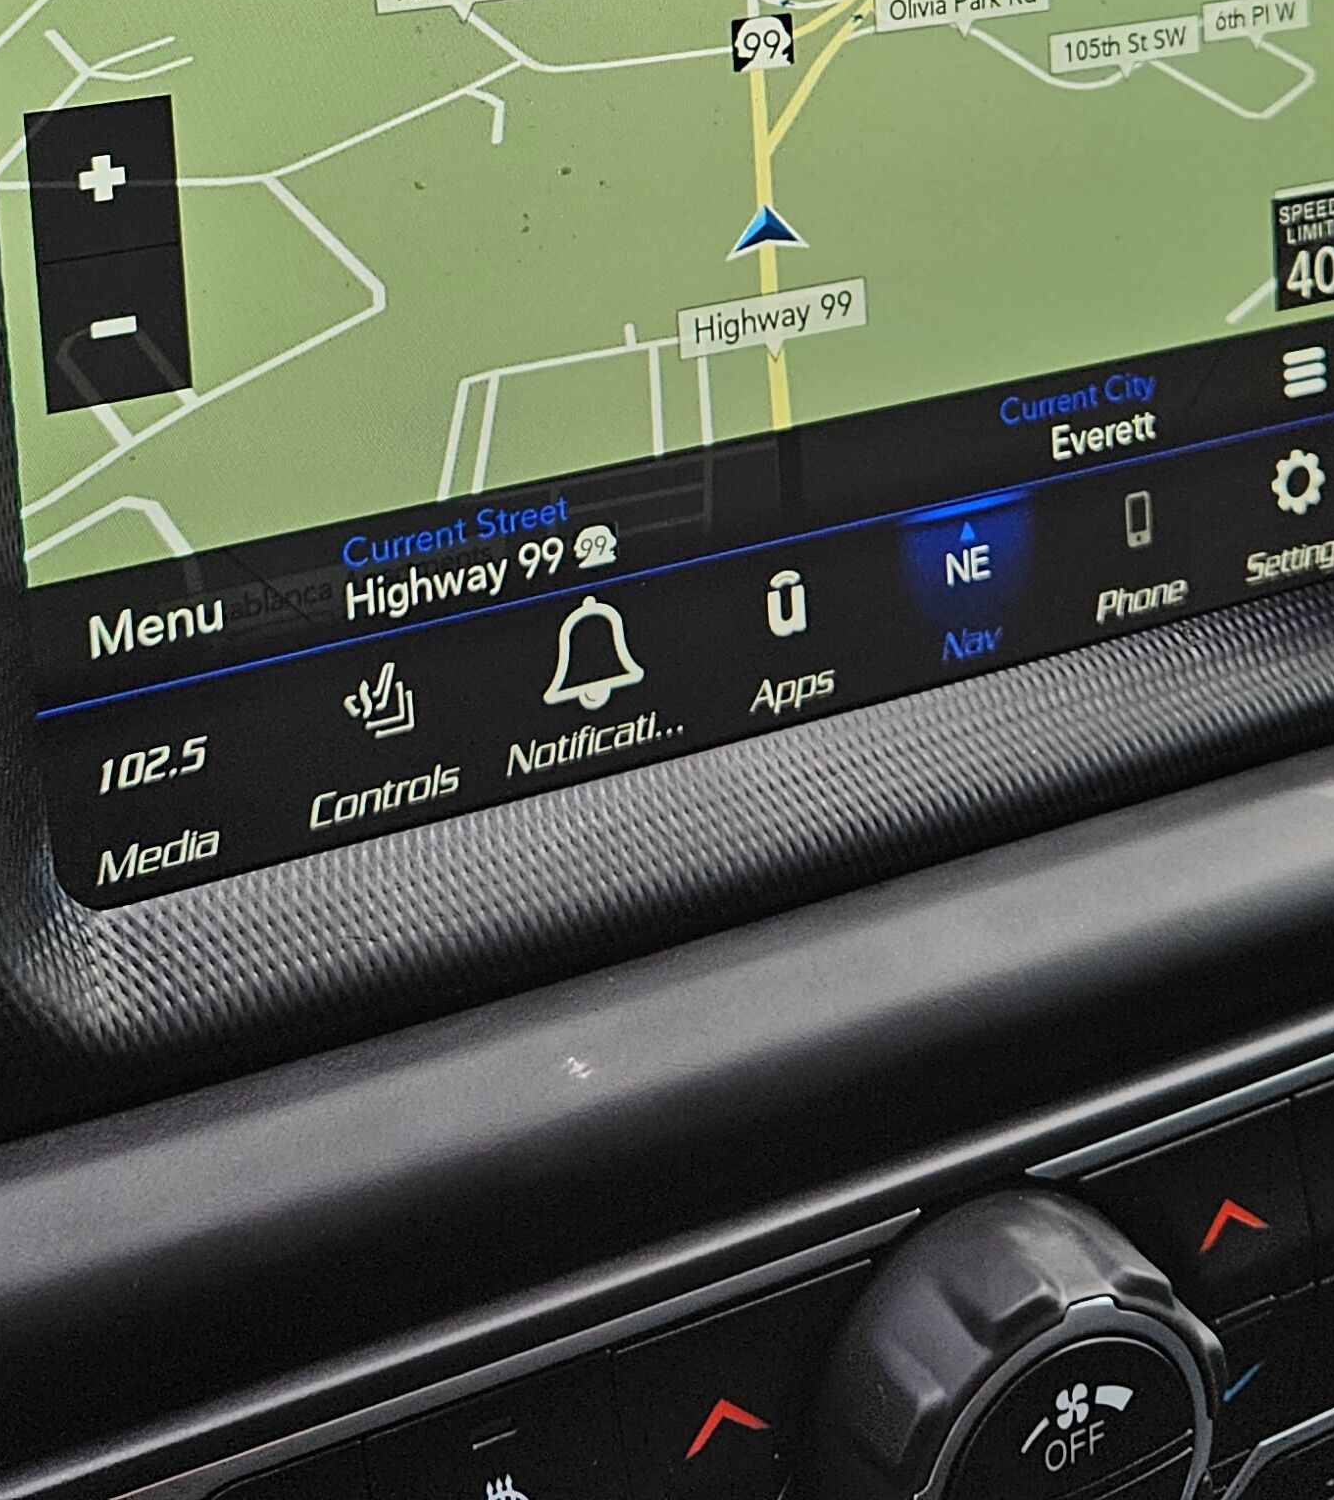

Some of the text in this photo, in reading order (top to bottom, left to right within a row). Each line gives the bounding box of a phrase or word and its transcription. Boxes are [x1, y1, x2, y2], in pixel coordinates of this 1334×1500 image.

[1215, 1, 1296, 32] 6th Pl W
[742, 29, 782, 61] 99
[1064, 26, 1187, 63] 105th St SW
[694, 290, 853, 346] Highway 99
[999, 371, 1158, 426] Current City
[1052, 412, 1157, 460] Everett
[342, 519, 466, 571] Current
[476, 497, 568, 537] Street
[345, 555, 508, 621] Highway
[518, 535, 565, 582] 99
[580, 534, 608, 562] 99
[945, 544, 993, 588] NE
[1095, 576, 1190, 624] Phone
[88, 598, 225, 660] Menu
[942, 623, 1004, 662] Nav
[749, 668, 836, 715] Apps
[97, 735, 209, 796] 102.5
[506, 712, 685, 778] Notificati...
[309, 764, 461, 831] Controls
[95, 825, 221, 888] Media
[1045, 1419, 1107, 1472] OFF
